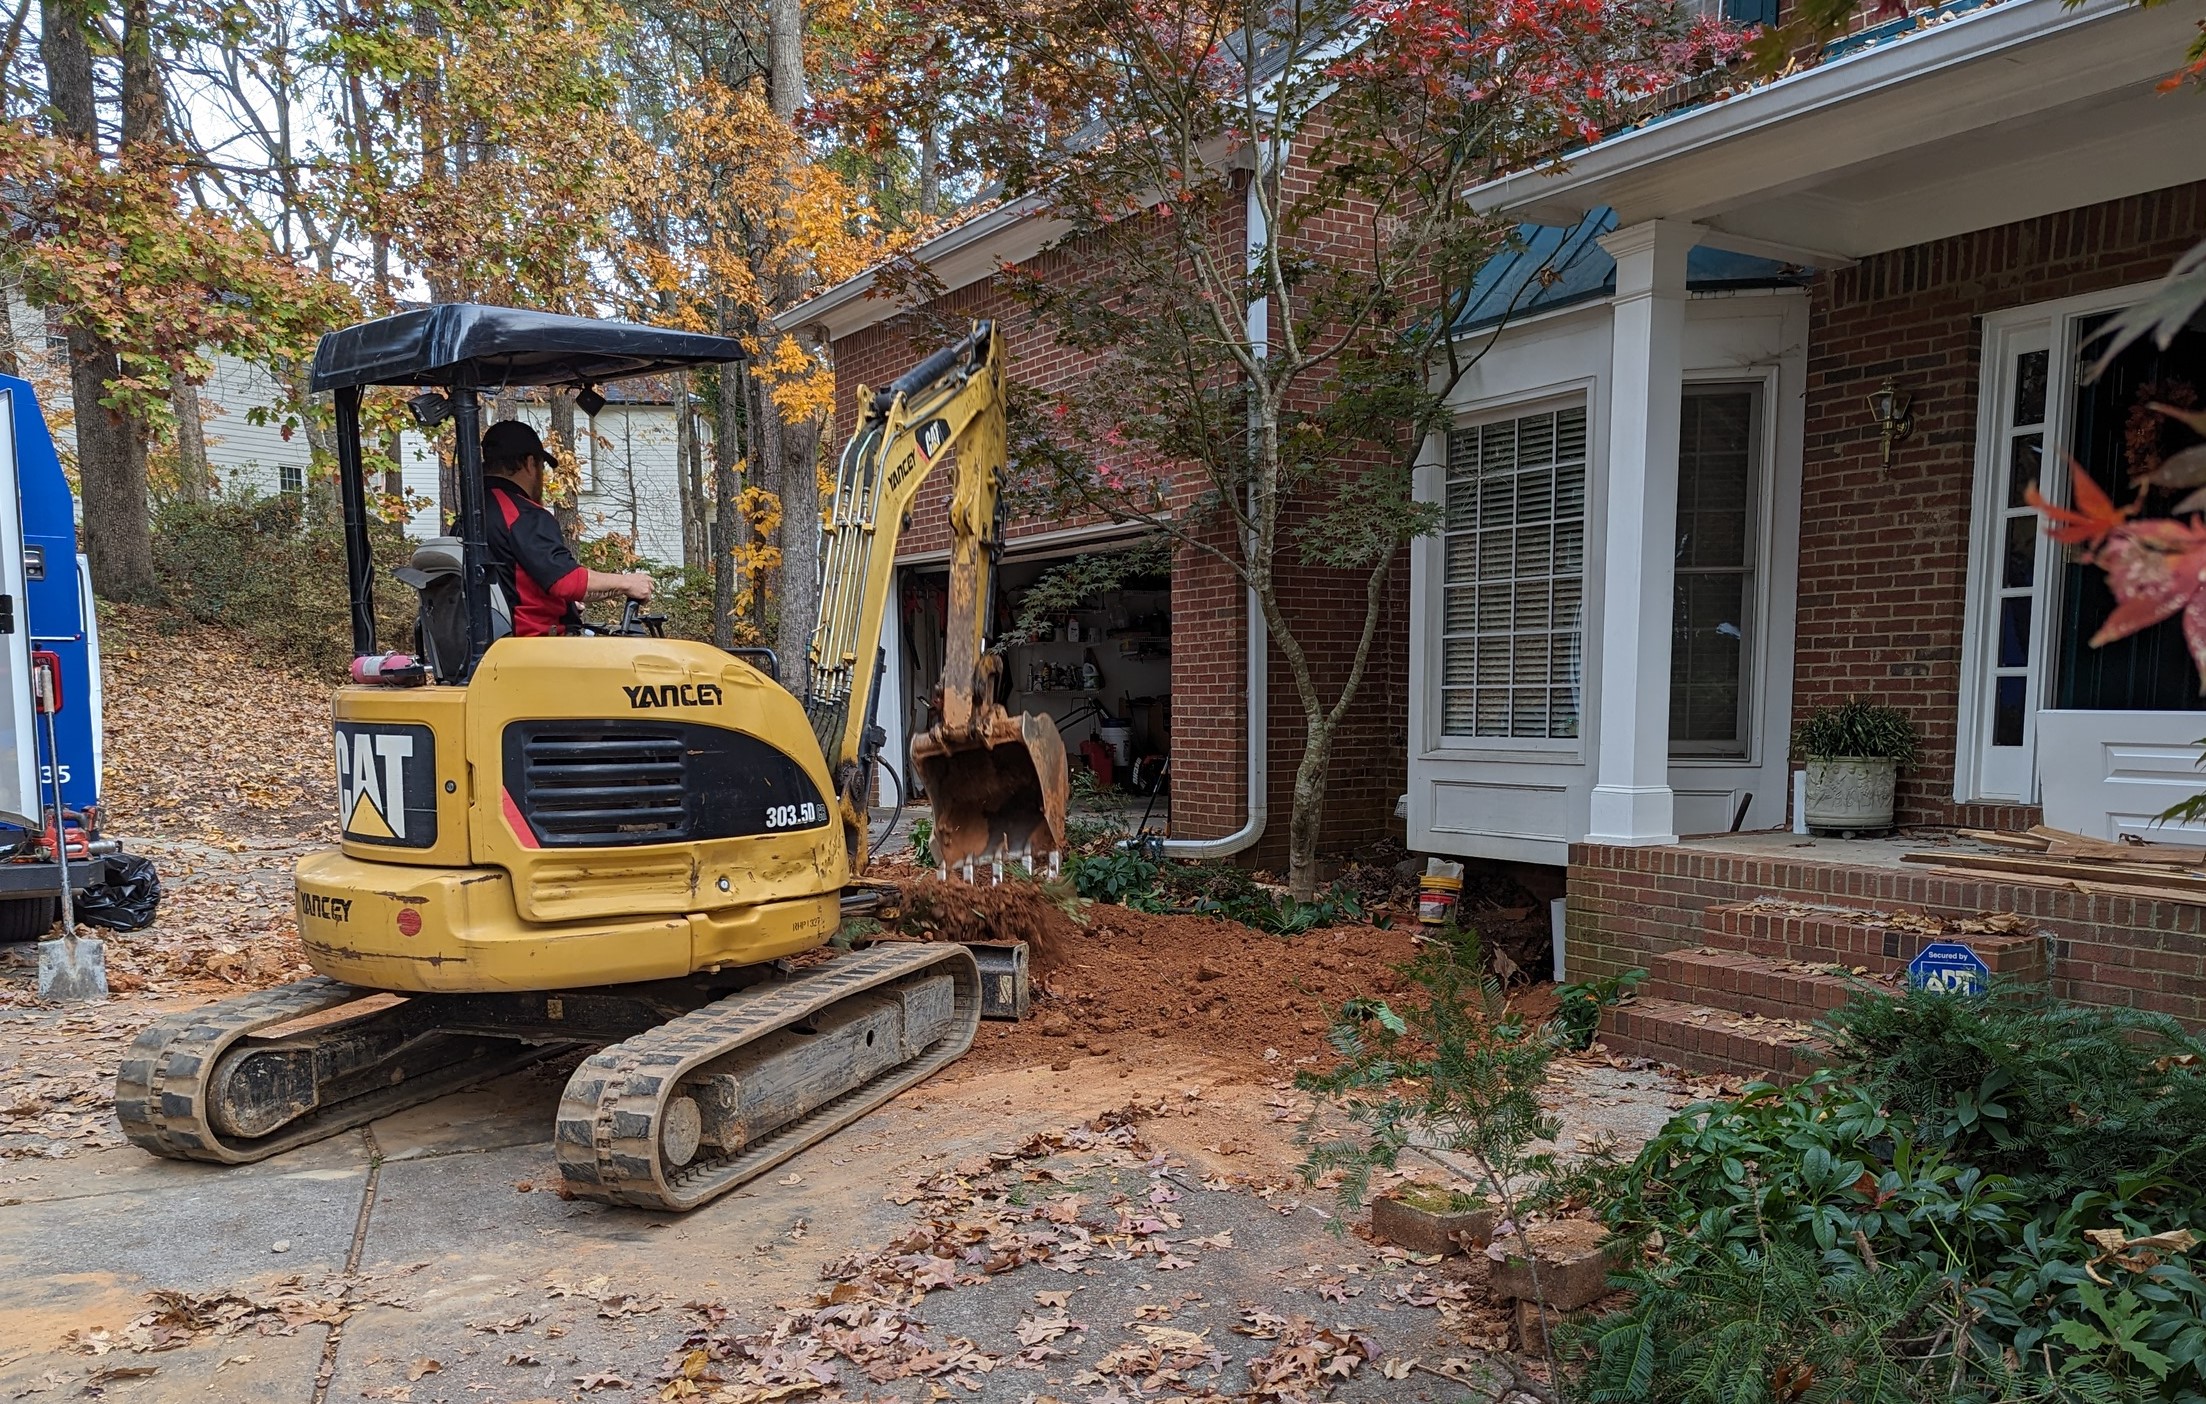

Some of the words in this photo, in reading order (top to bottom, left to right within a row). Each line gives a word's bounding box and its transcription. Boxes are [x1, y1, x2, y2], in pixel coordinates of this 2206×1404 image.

[925, 420, 941, 457] CAT
[888, 448, 916, 492] YANCEY
[622, 684, 722, 709] YANCEY
[335, 730, 414, 839] CAT
[765, 802, 816, 828] 303.5D
[301, 891, 353, 922] YANCEY
[1928, 951, 1957, 960] Secured
[1958, 953, 1968, 961] by
[1925, 969, 1976, 997] ADT
